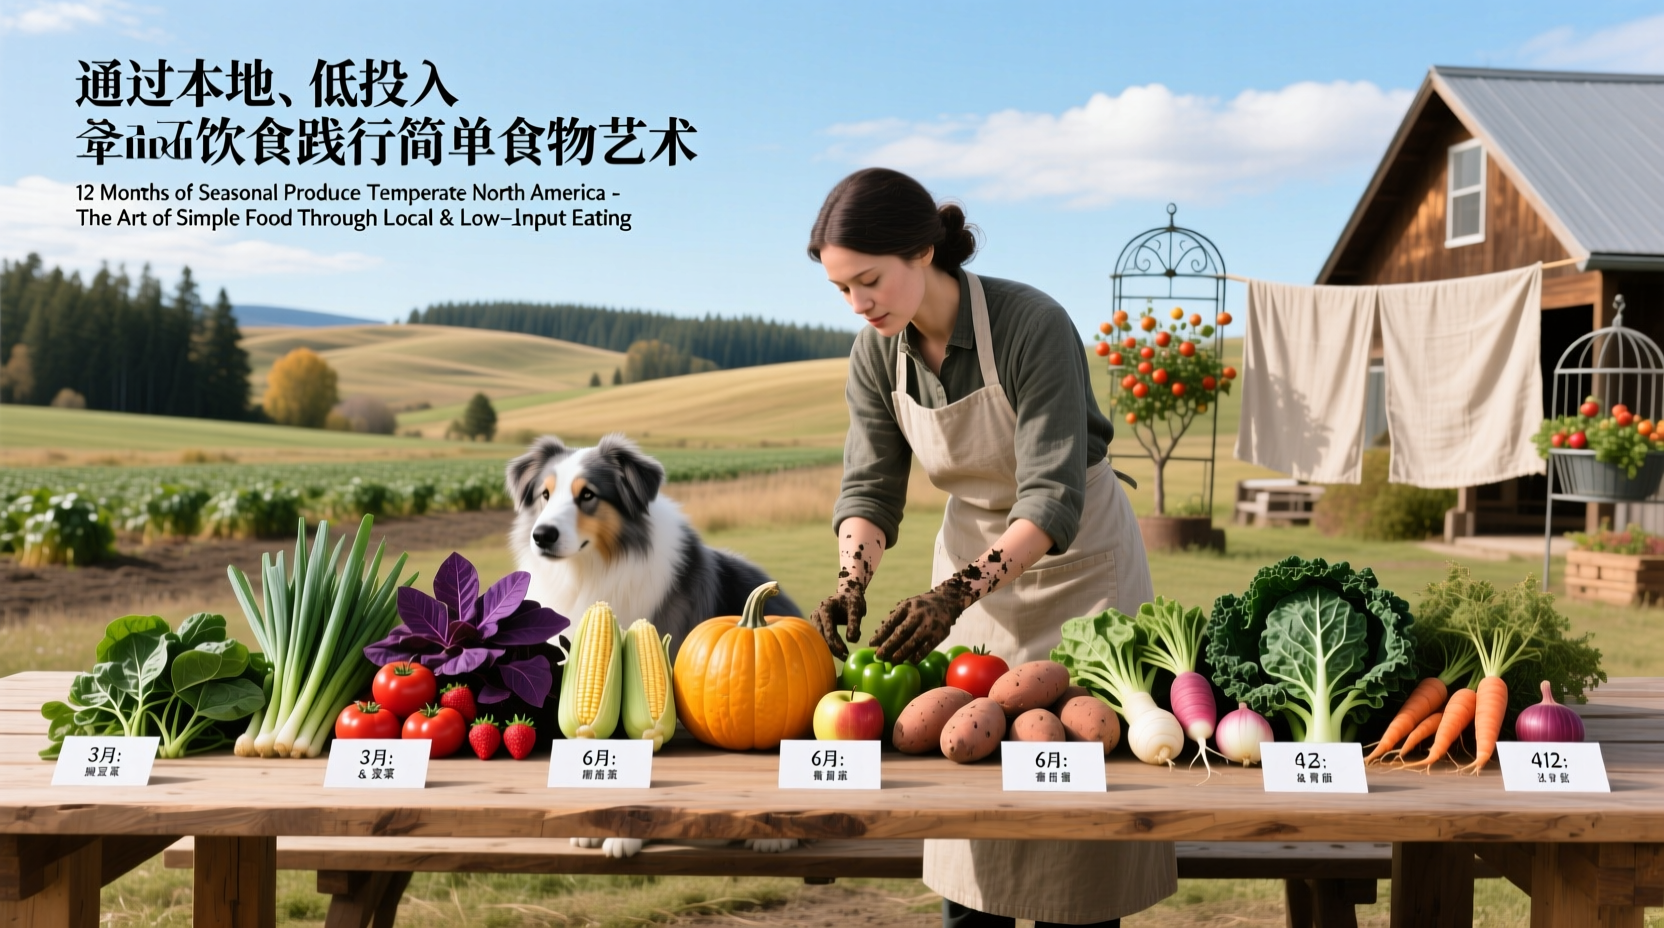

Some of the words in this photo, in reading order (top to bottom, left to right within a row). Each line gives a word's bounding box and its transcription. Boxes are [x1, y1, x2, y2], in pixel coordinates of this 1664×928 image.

[87, 746, 122, 764] 3月:
[359, 748, 393, 767] 3月:
[582, 748, 617, 767] 6月:
[811, 749, 844, 768] 6月:
[1035, 751, 1068, 769] 6月:
